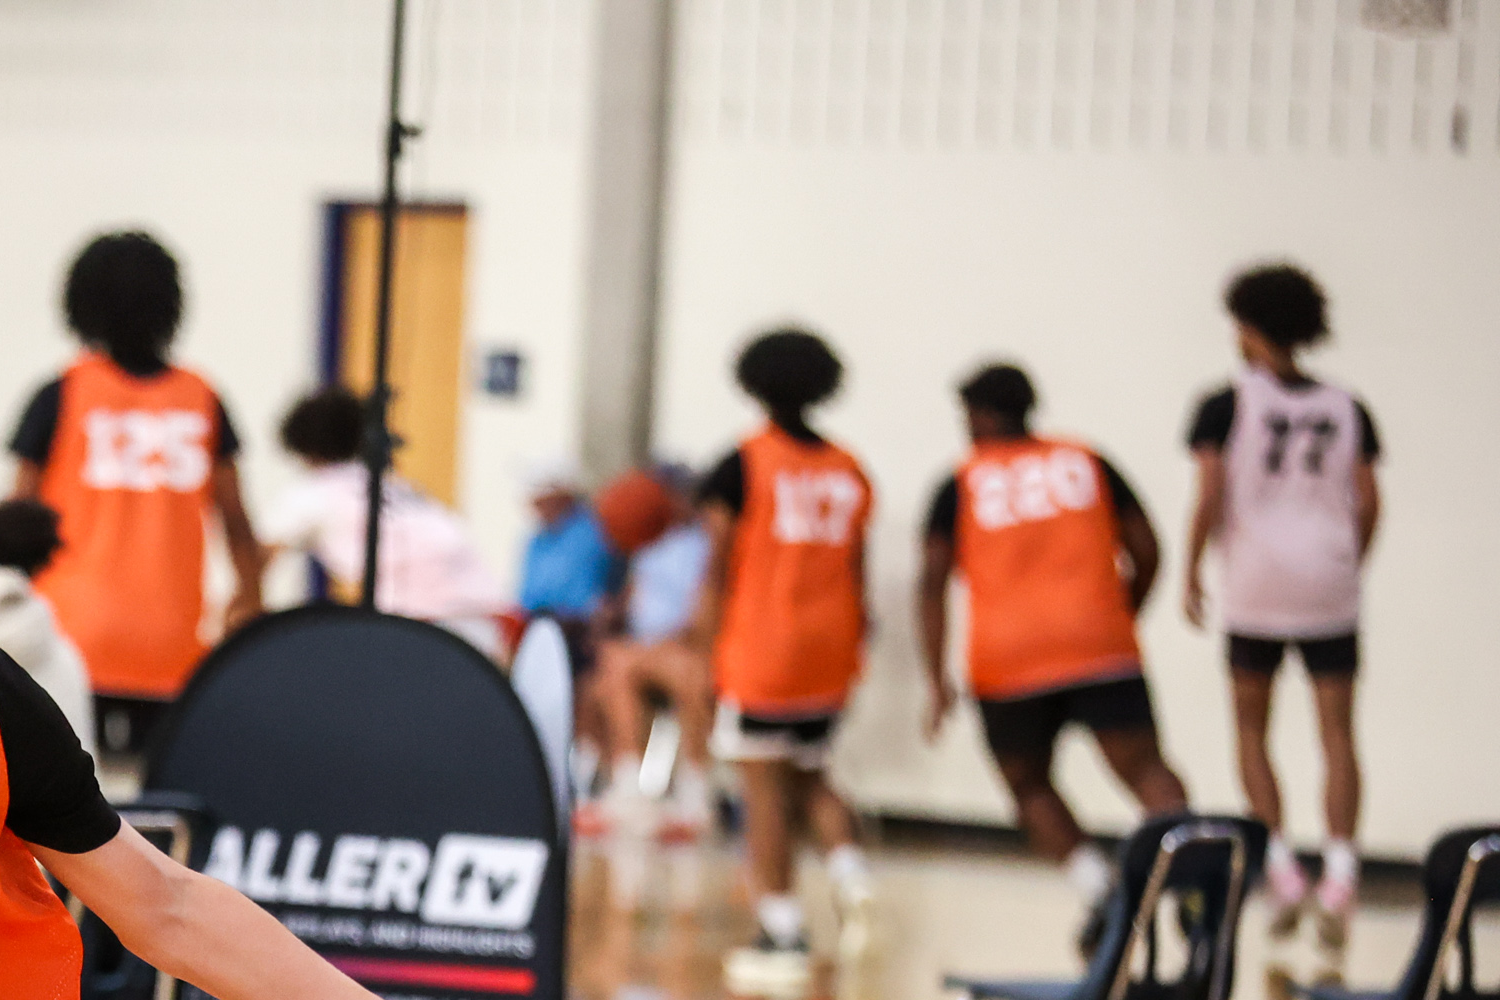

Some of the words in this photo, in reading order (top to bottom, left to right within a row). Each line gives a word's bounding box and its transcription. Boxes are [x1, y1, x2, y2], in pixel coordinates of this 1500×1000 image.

[82, 410, 212, 491] 125
[1263, 410, 1339, 475] 77
[203, 826, 430, 912] ALLER
